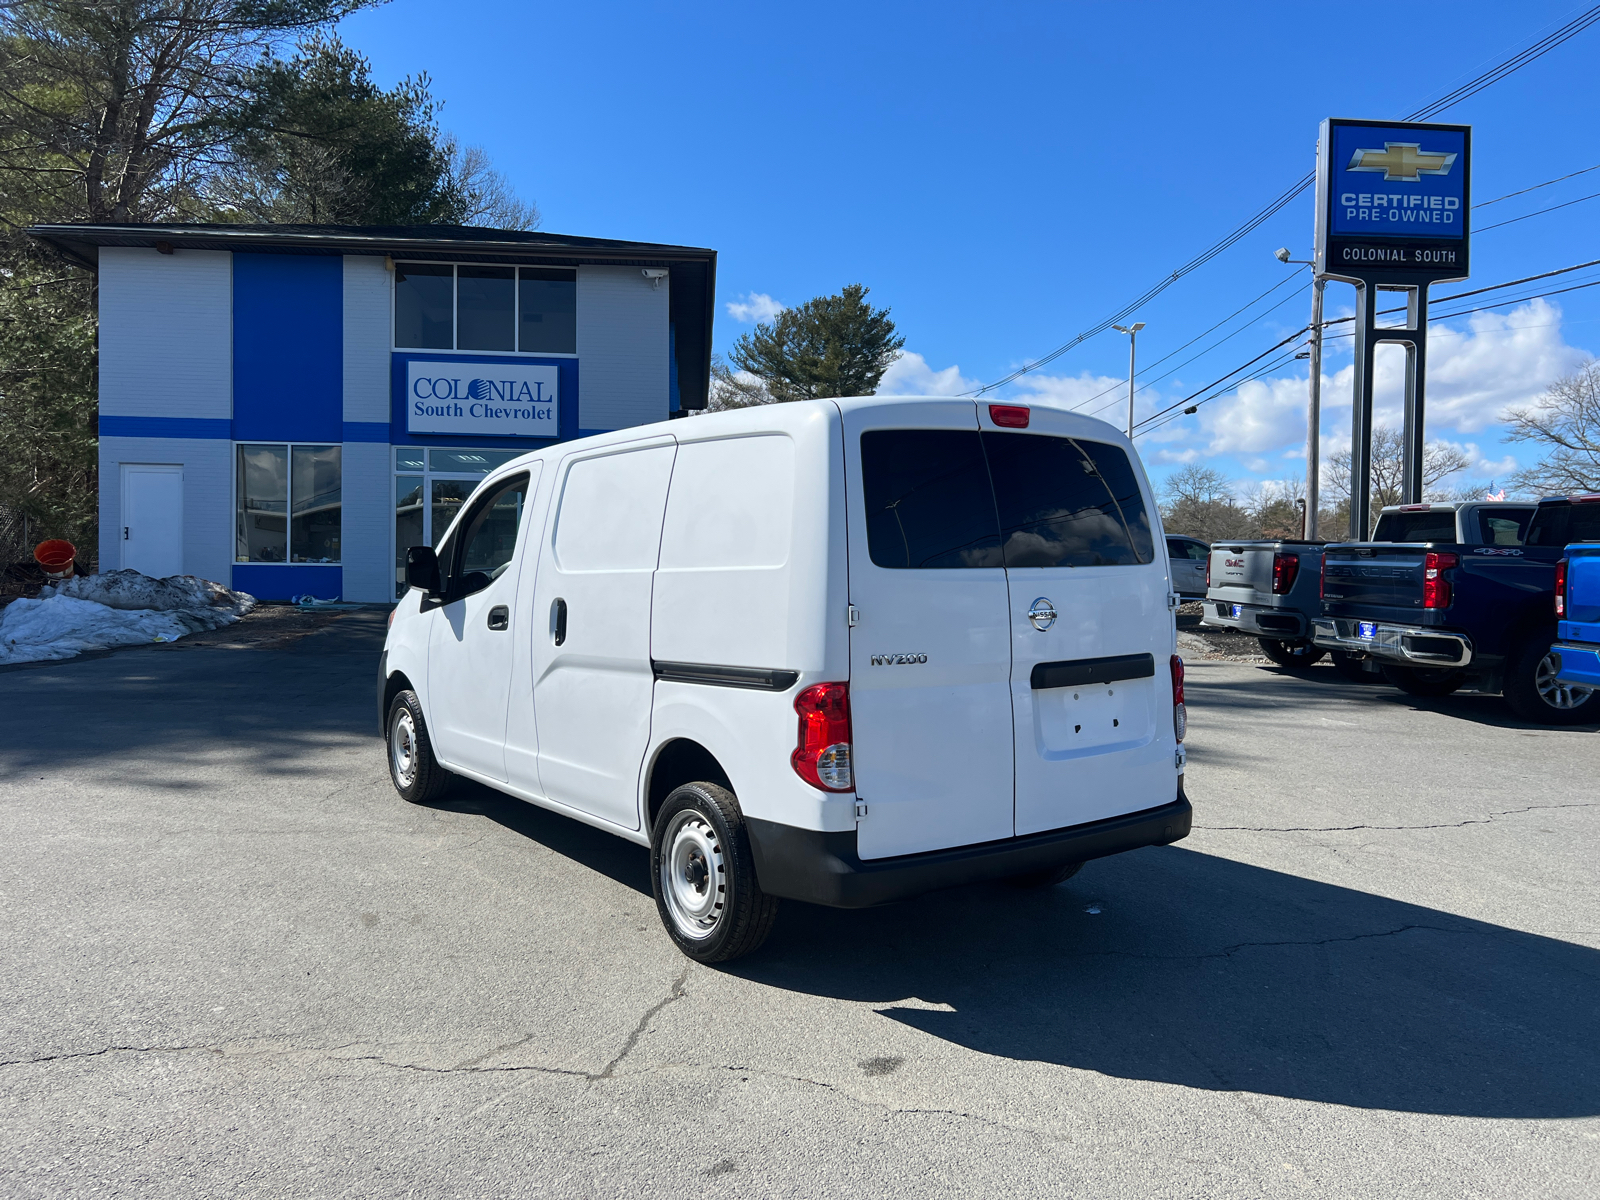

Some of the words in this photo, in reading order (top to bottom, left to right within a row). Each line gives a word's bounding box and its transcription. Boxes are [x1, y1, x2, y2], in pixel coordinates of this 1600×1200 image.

[1341, 193, 1459, 209] CERTIFIED
[1346, 208, 1454, 223] PRE-OWNED
[1342, 247, 1407, 262] COLONIAL
[1415, 249, 1456, 262] SOUTH
[413, 377, 553, 403] COLONIAL
[414, 401, 463, 417] South
[469, 403, 552, 420] Chevrolet
[871, 652, 928, 666] NV200
